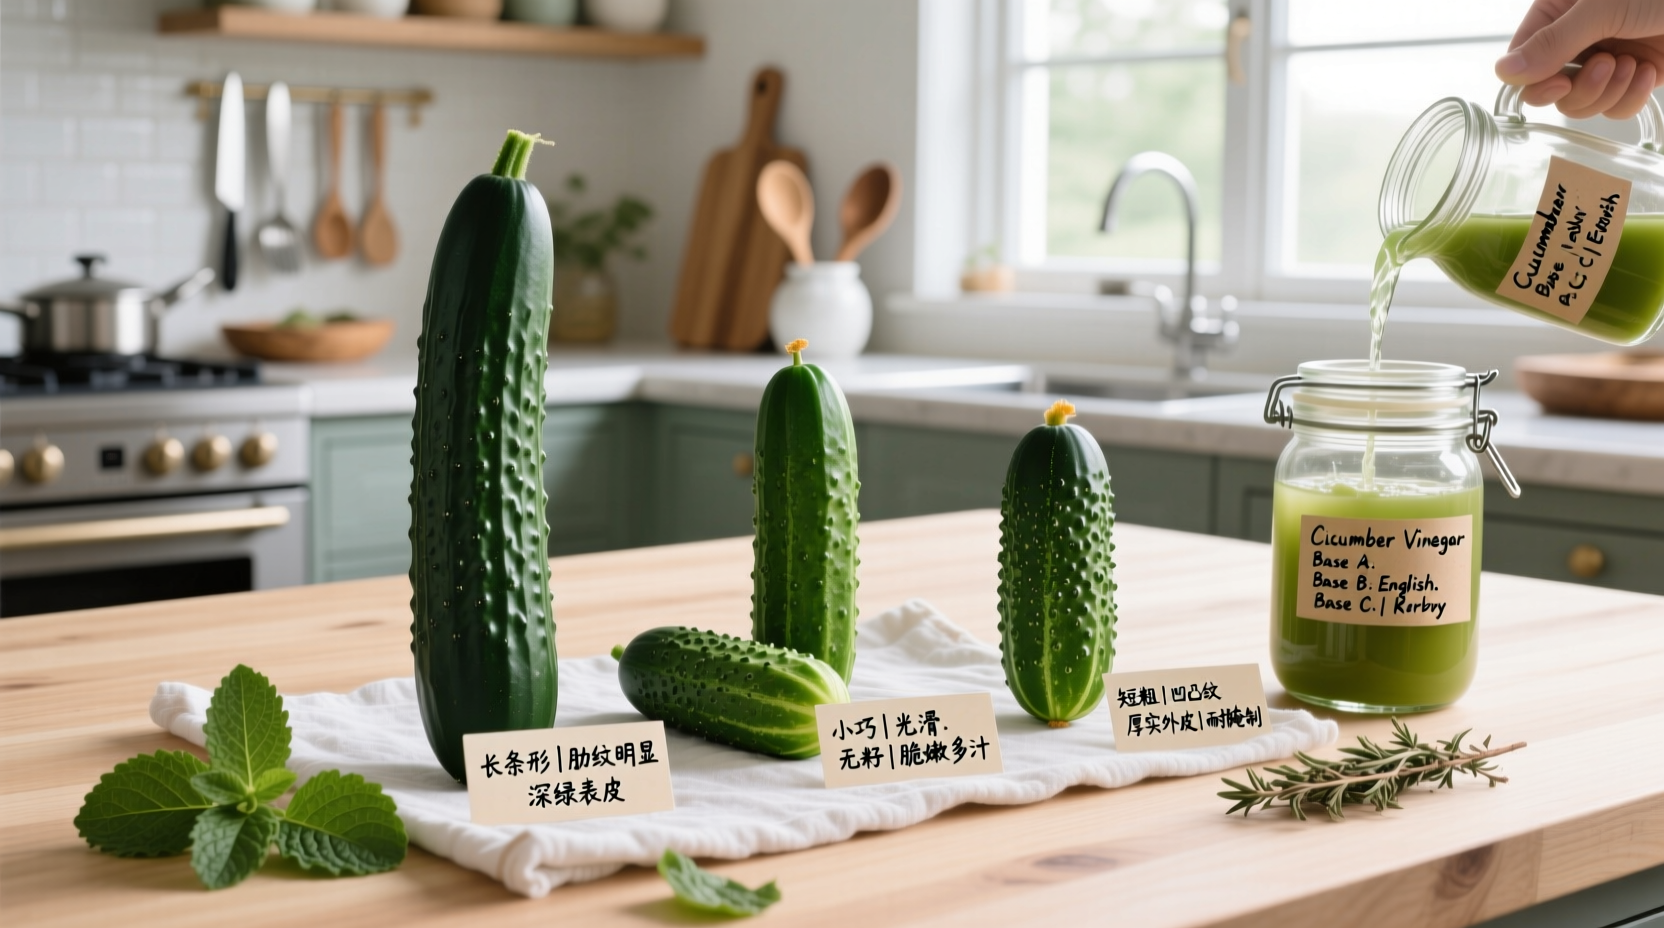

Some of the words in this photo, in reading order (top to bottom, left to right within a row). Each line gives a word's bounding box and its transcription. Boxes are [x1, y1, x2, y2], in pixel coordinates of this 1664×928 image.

[1310, 524, 1395, 548] Cicumber
[1404, 528, 1465, 555] Vinegar
[1312, 551, 1349, 569] Base
[1356, 554, 1375, 569] A.
[1312, 571, 1349, 590] Base
[1378, 573, 1439, 597] English.
[1314, 592, 1352, 611] Base
[528, 776, 625, 808] 深绿表皮
